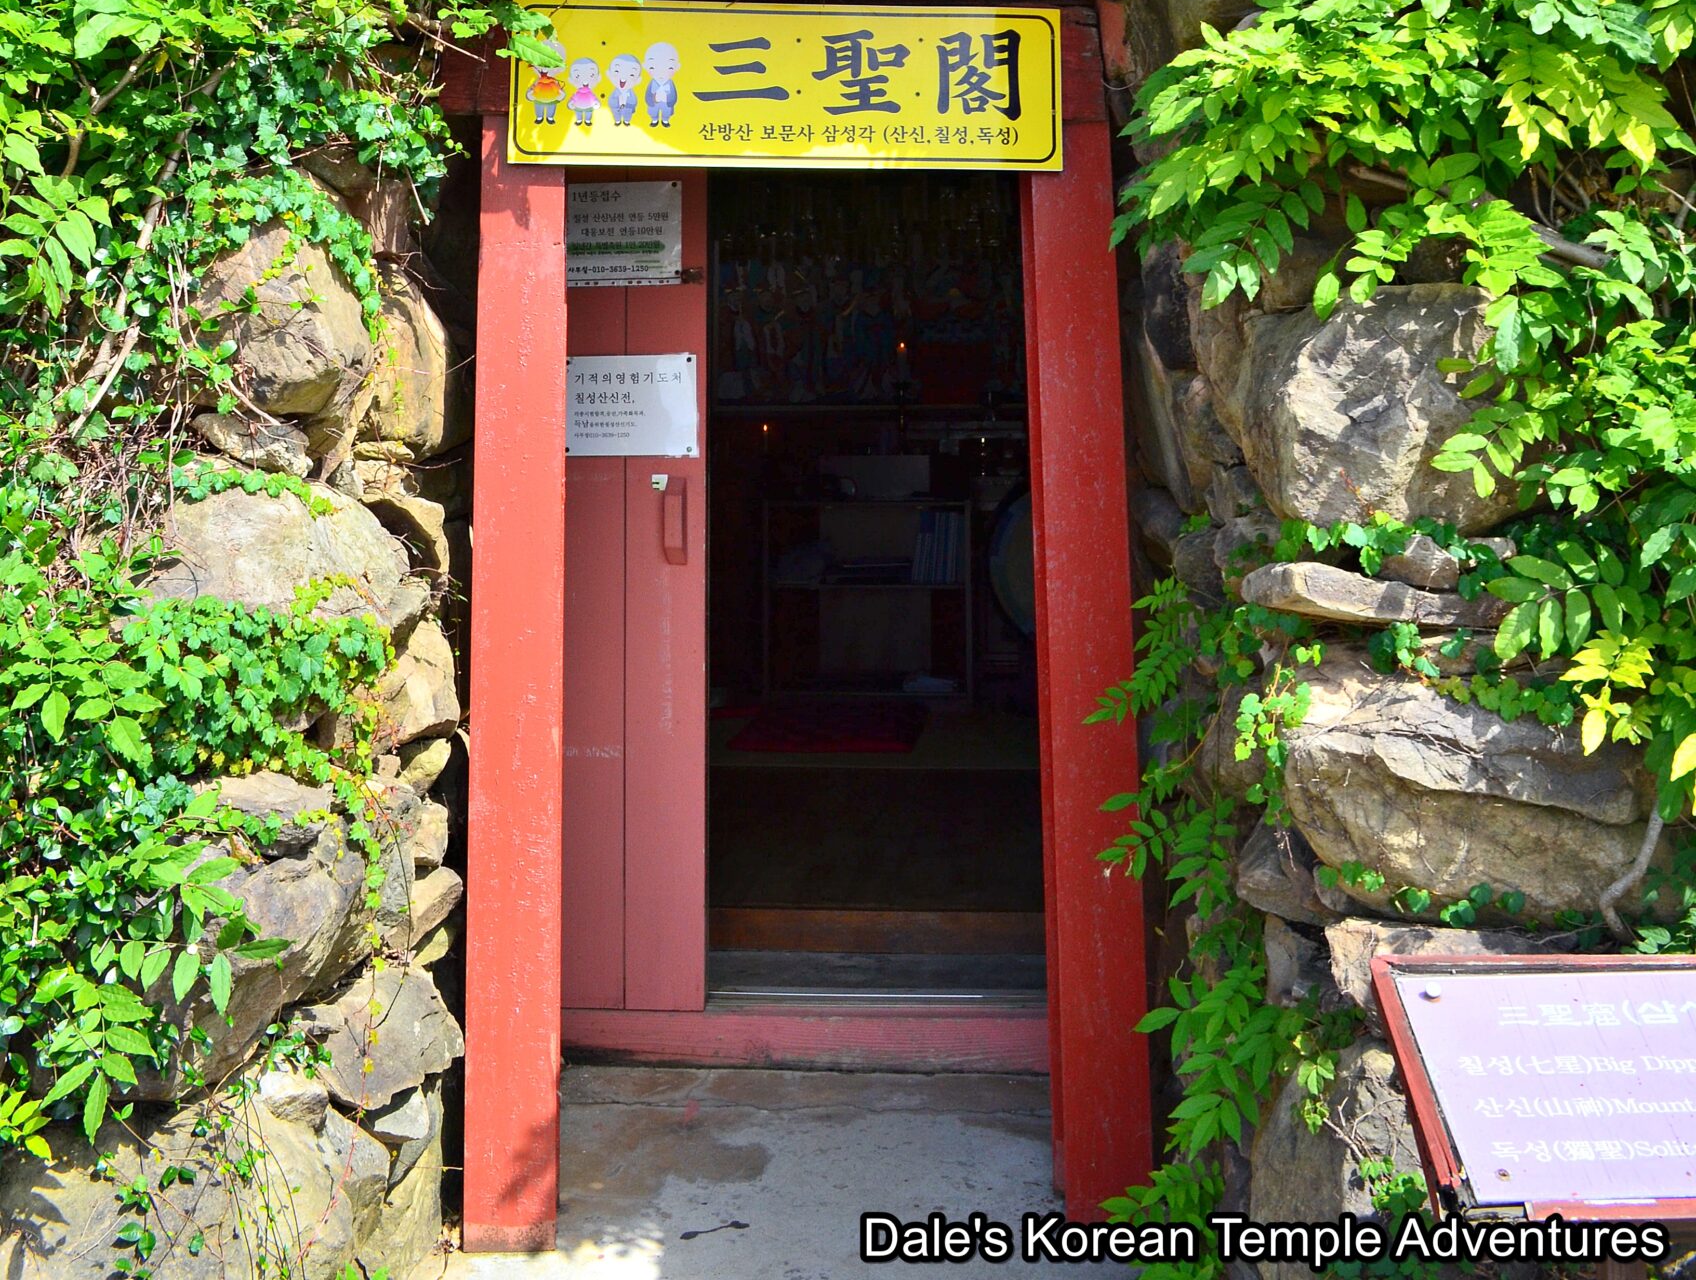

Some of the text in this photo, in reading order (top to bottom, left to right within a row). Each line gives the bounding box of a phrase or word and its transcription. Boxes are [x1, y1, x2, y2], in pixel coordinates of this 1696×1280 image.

[692, 27, 1022, 122] 三聖閣
[698, 122, 754, 142] 산방산
[760, 123, 816, 143] 보문사
[821, 123, 876, 144] 삼성각
